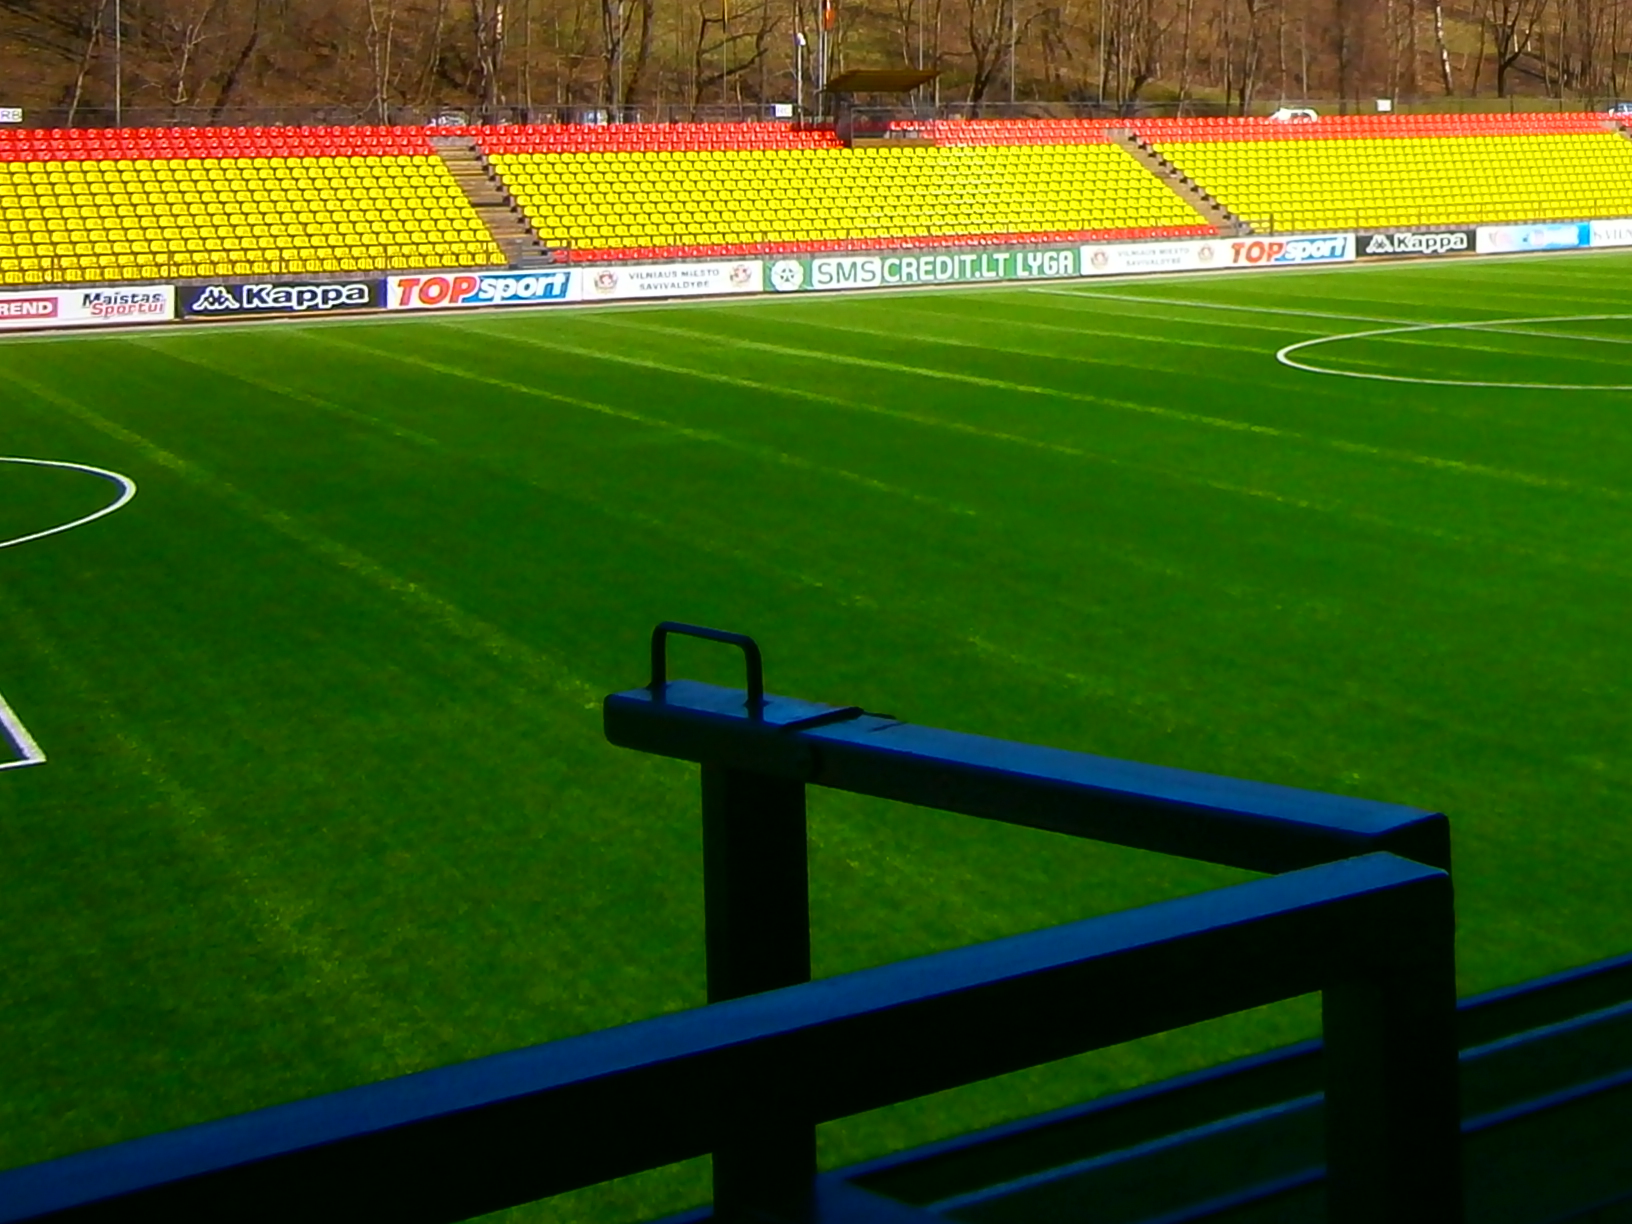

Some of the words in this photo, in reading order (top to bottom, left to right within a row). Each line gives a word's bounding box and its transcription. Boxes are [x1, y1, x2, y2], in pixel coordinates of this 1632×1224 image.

[1394, 233, 1468, 253] Kappa
[1017, 250, 1073, 275] LYGA
[628, 270, 678, 281] VILNIAUS
[681, 268, 720, 277] MIESTO
[82, 292, 165, 307] Maistas
[242, 284, 370, 310] Kappa
[90, 302, 165, 318] Sportui
